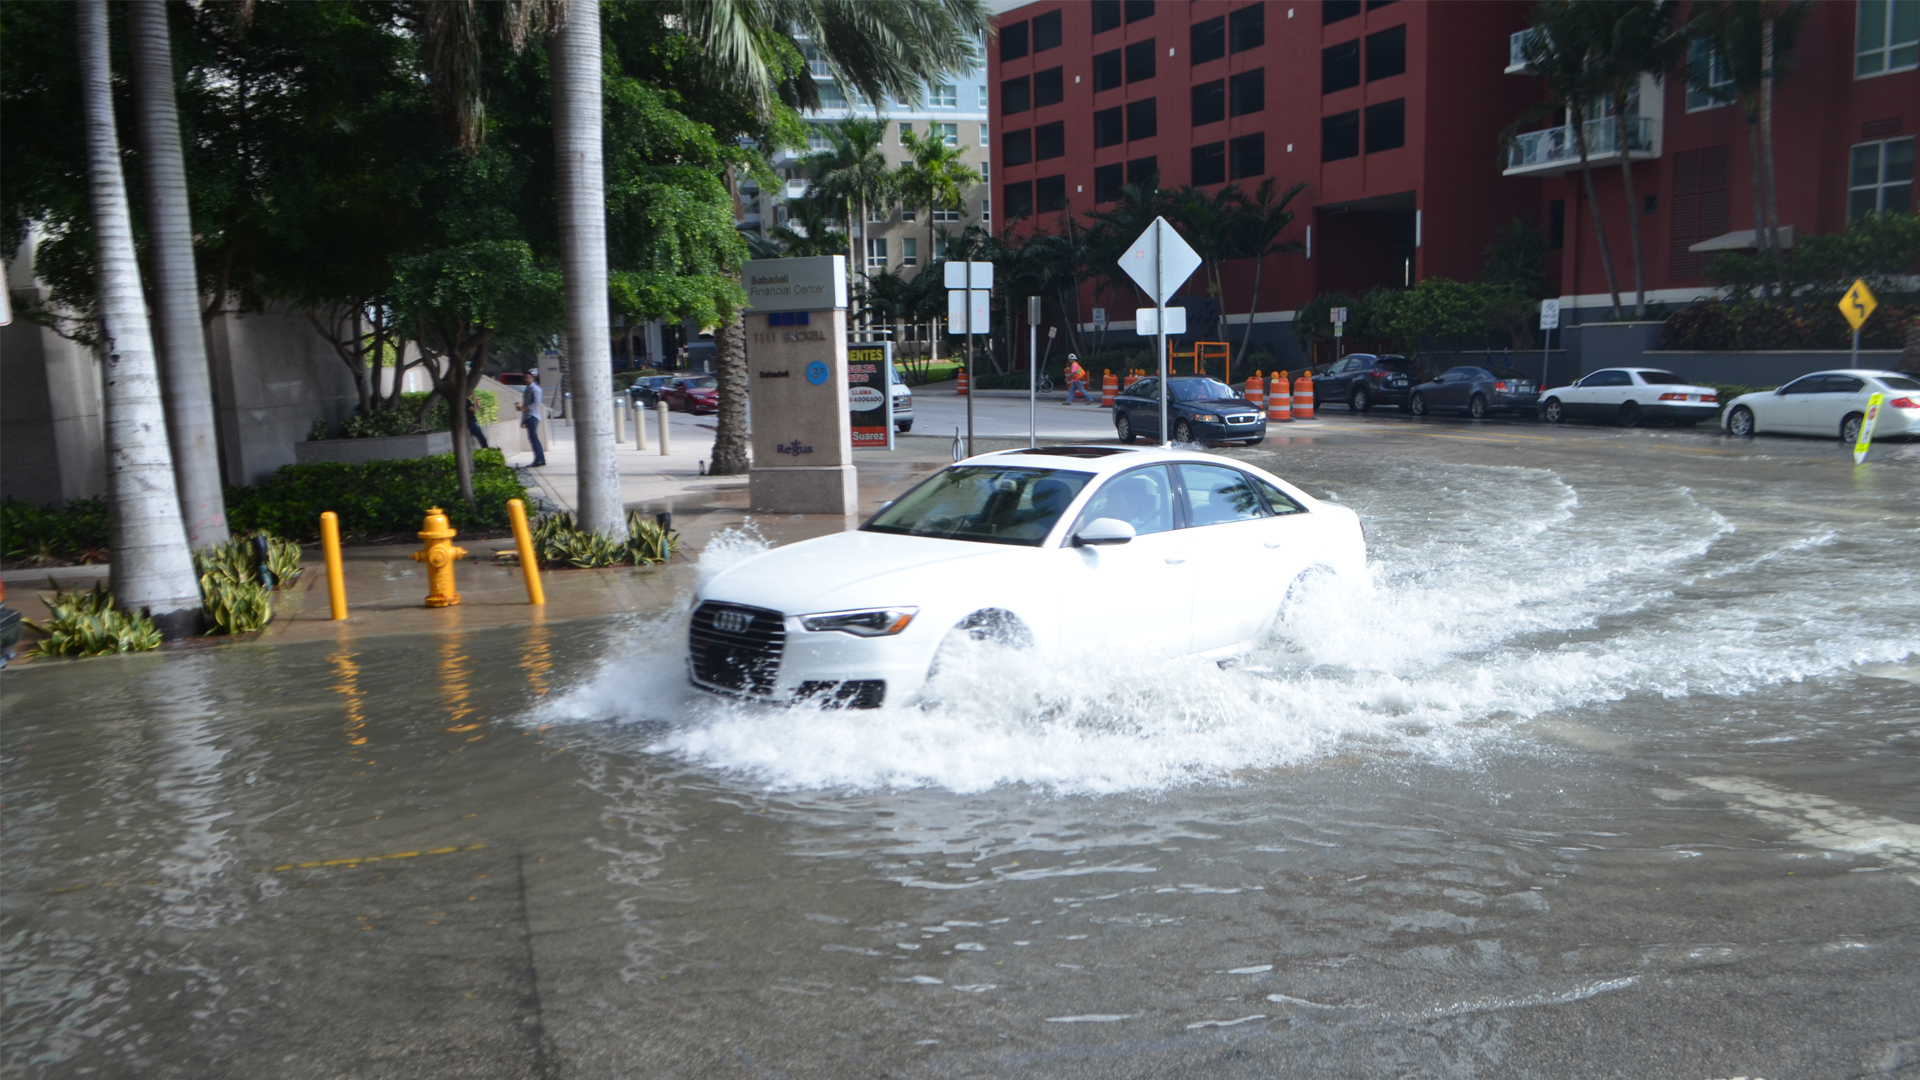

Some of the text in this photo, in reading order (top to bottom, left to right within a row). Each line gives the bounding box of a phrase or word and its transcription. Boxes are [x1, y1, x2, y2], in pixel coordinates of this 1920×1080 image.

[751, 274, 789, 285] Sabadell
[751, 284, 825, 296] Financial Center
[759, 370, 789, 378] Sabadell
[852, 431, 884, 440] Suarez
[777, 442, 813, 456] Regus
